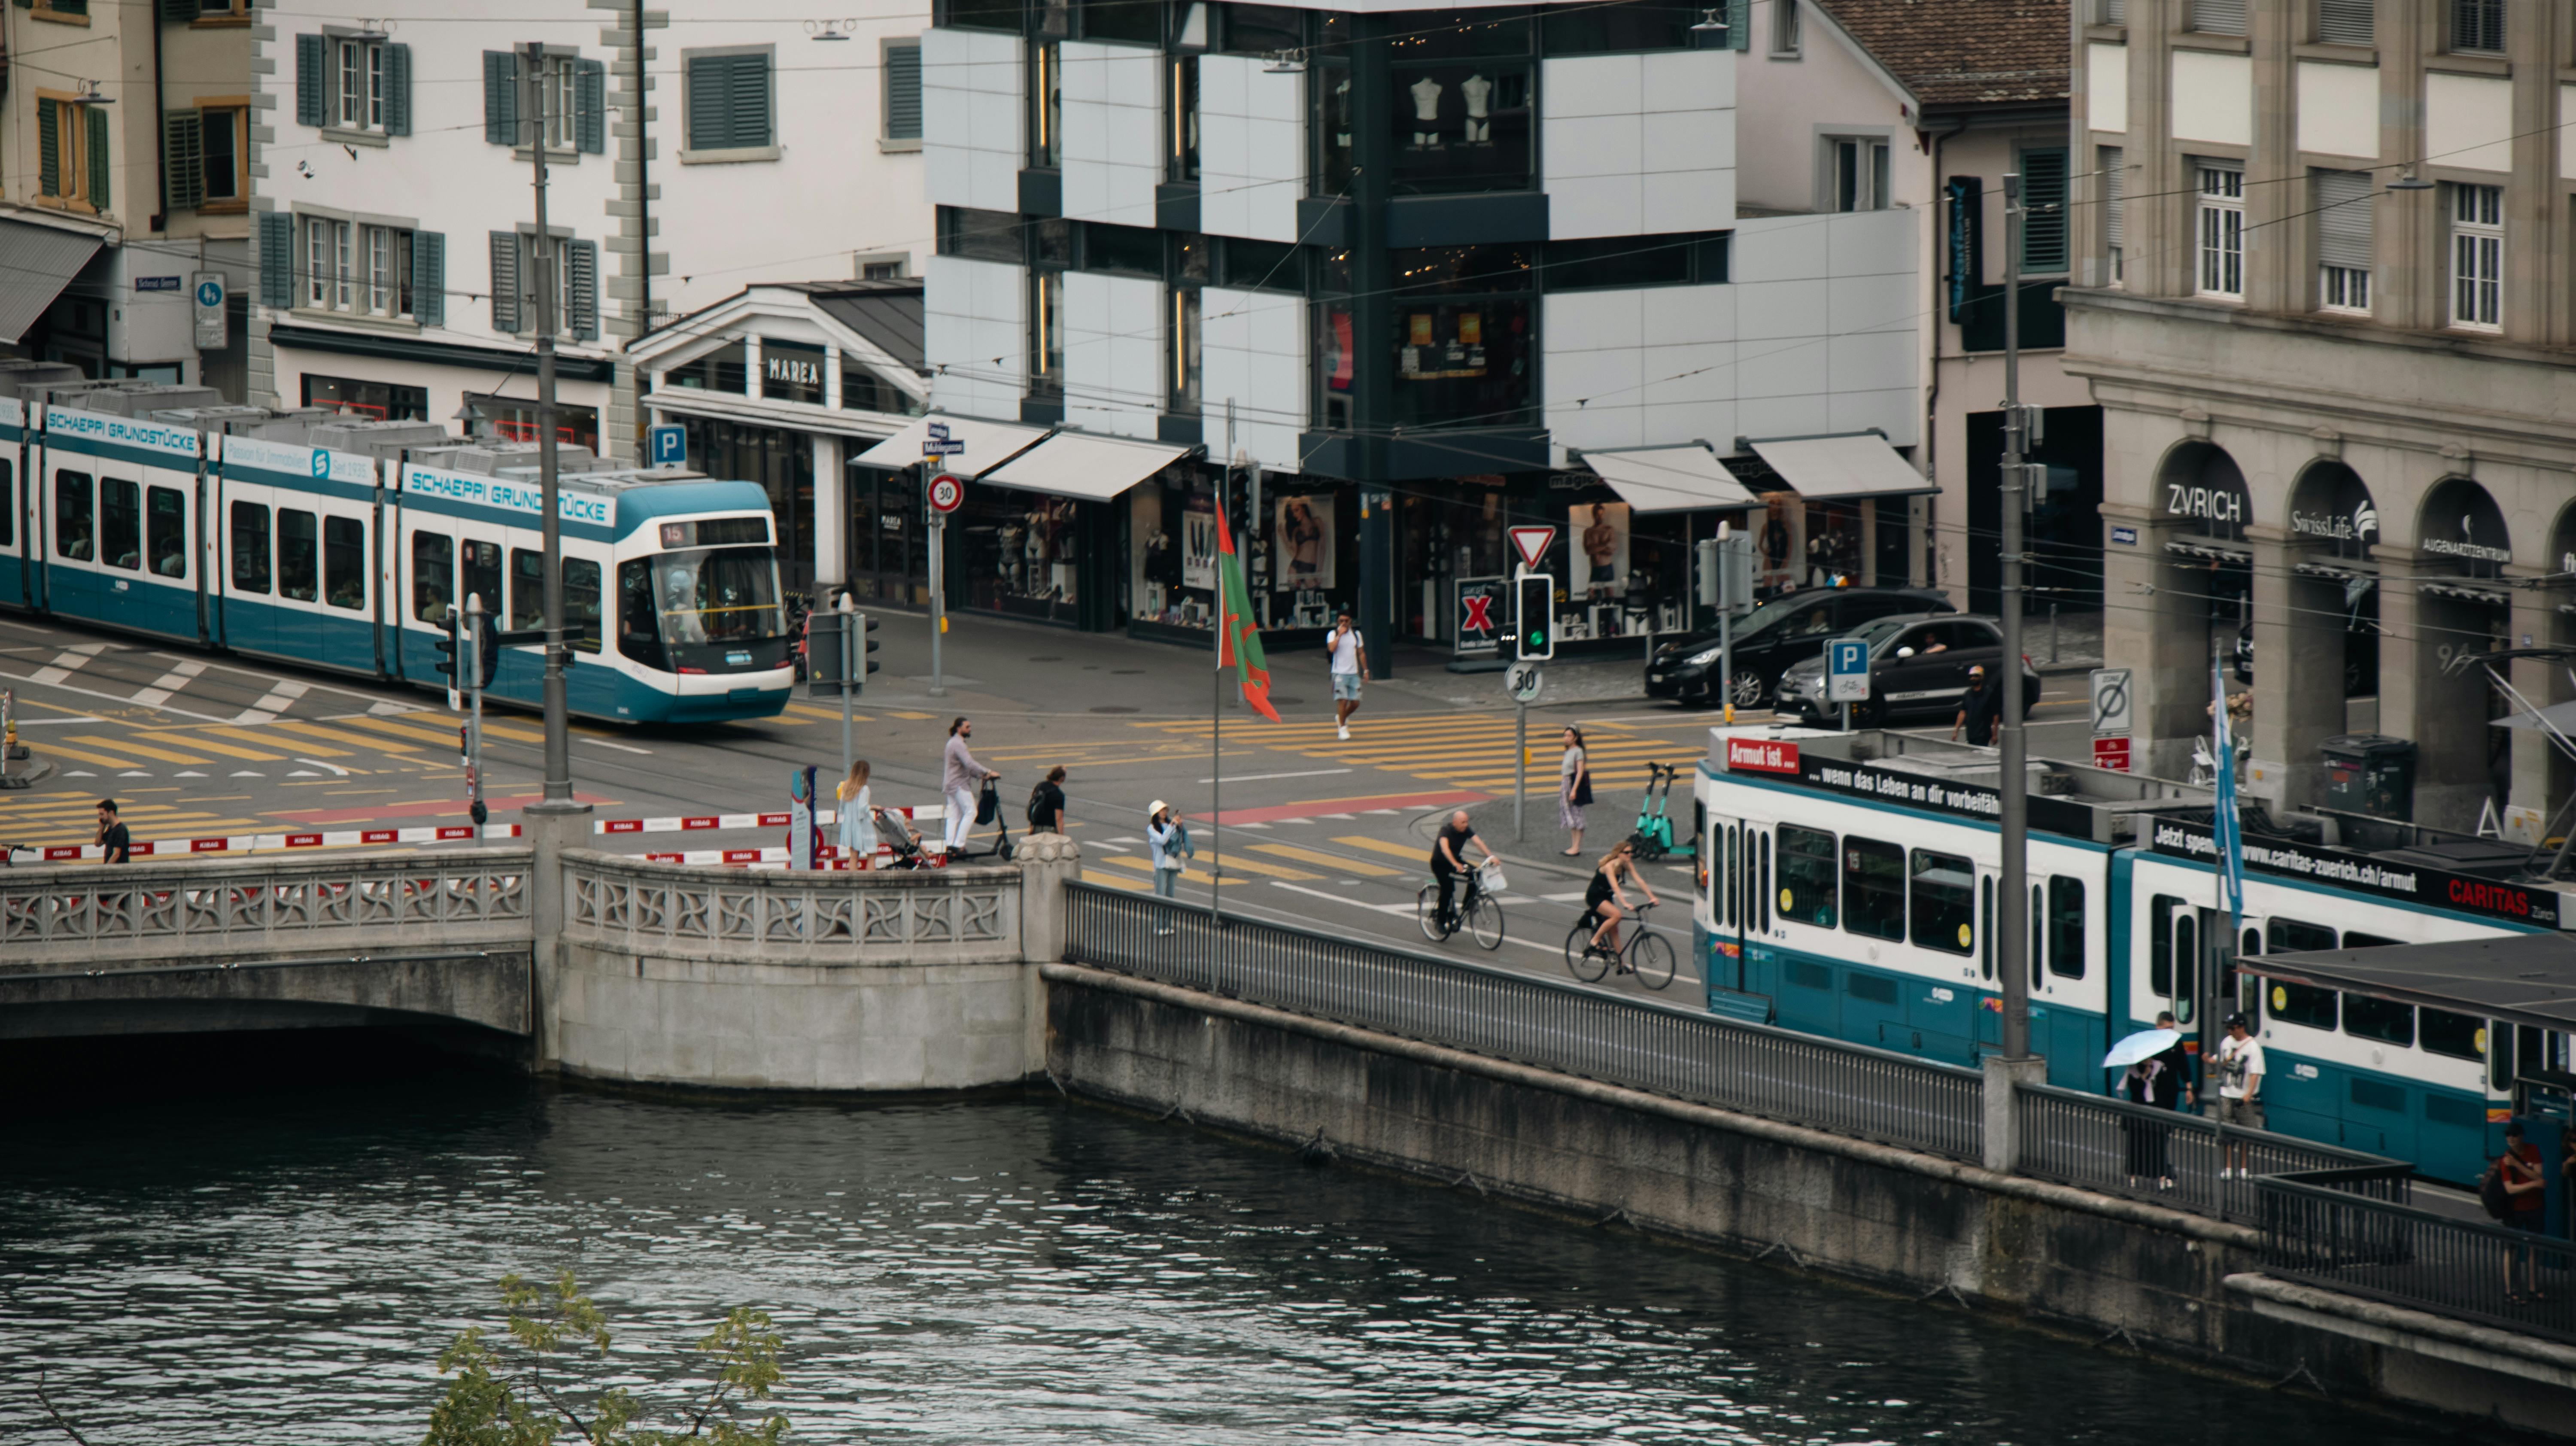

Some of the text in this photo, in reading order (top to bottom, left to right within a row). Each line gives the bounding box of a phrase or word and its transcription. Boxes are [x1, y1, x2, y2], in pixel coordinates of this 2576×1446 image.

[769, 358, 819, 384] MAREA
[48, 413, 195, 451] SCHAEPPI GRUNDSTÜCKE
[663, 433, 677, 458] P
[412, 473, 606, 521] SCHAEPPI GRUNDTÜCKE
[939, 486, 952, 500] 30
[665, 526, 683, 541] 15
[1843, 646, 1858, 671] P
[1516, 670, 1535, 691] 30
[1731, 742, 1765, 765] Armut
[1767, 745, 1782, 767] ist
[1822, 767, 1852, 787] wenn
[1854, 769, 1874, 791] das
[1876, 773, 1909, 798] Leben
[1911, 784, 1926, 801] an
[1928, 784, 1945, 804] dir
[2155, 824, 2184, 848] Jetzt
[2449, 879, 2528, 916] CARITAS
